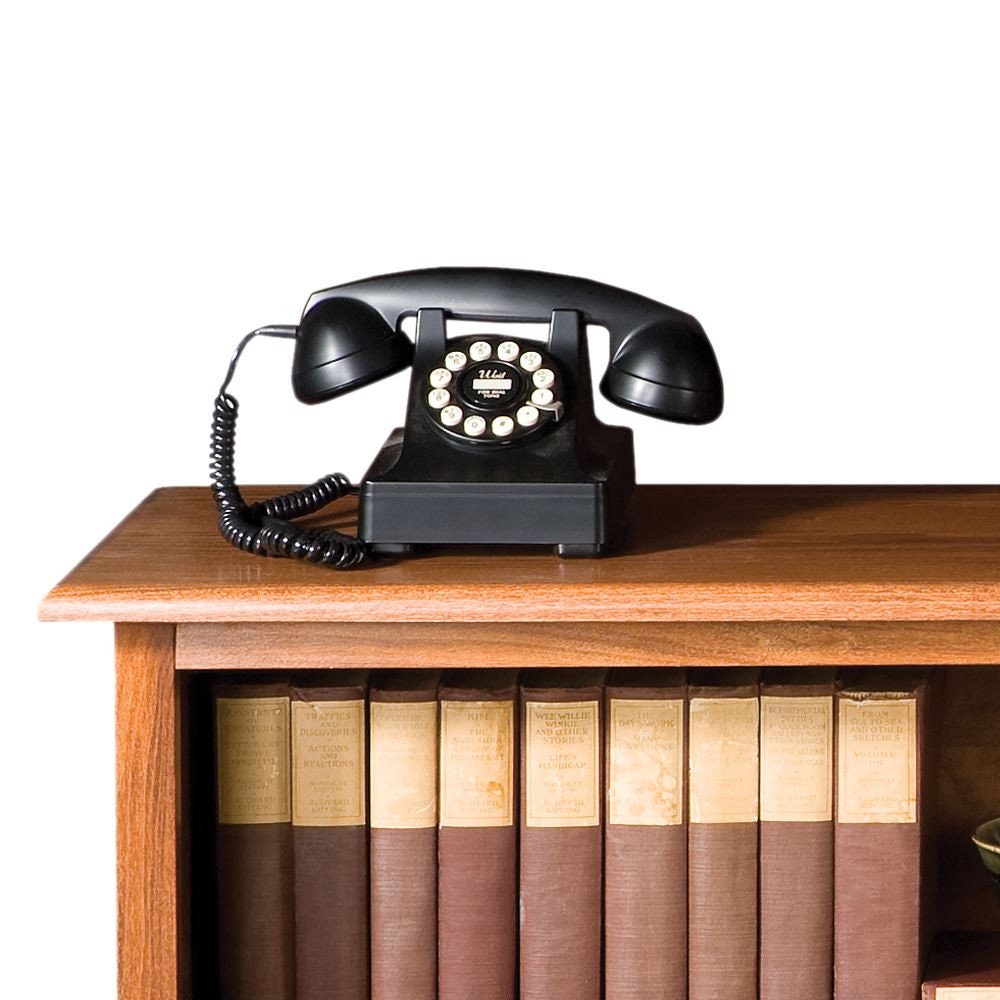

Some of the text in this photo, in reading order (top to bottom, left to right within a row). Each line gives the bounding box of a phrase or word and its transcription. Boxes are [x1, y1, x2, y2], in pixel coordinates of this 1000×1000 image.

[467, 712, 489, 721] KIM
[557, 711, 592, 720] WILLIE
[861, 711, 889, 719] FROM
[535, 728, 589, 736] AND OTHER
[542, 736, 585, 745] STORIES
[309, 744, 350, 752] ACTIONS
